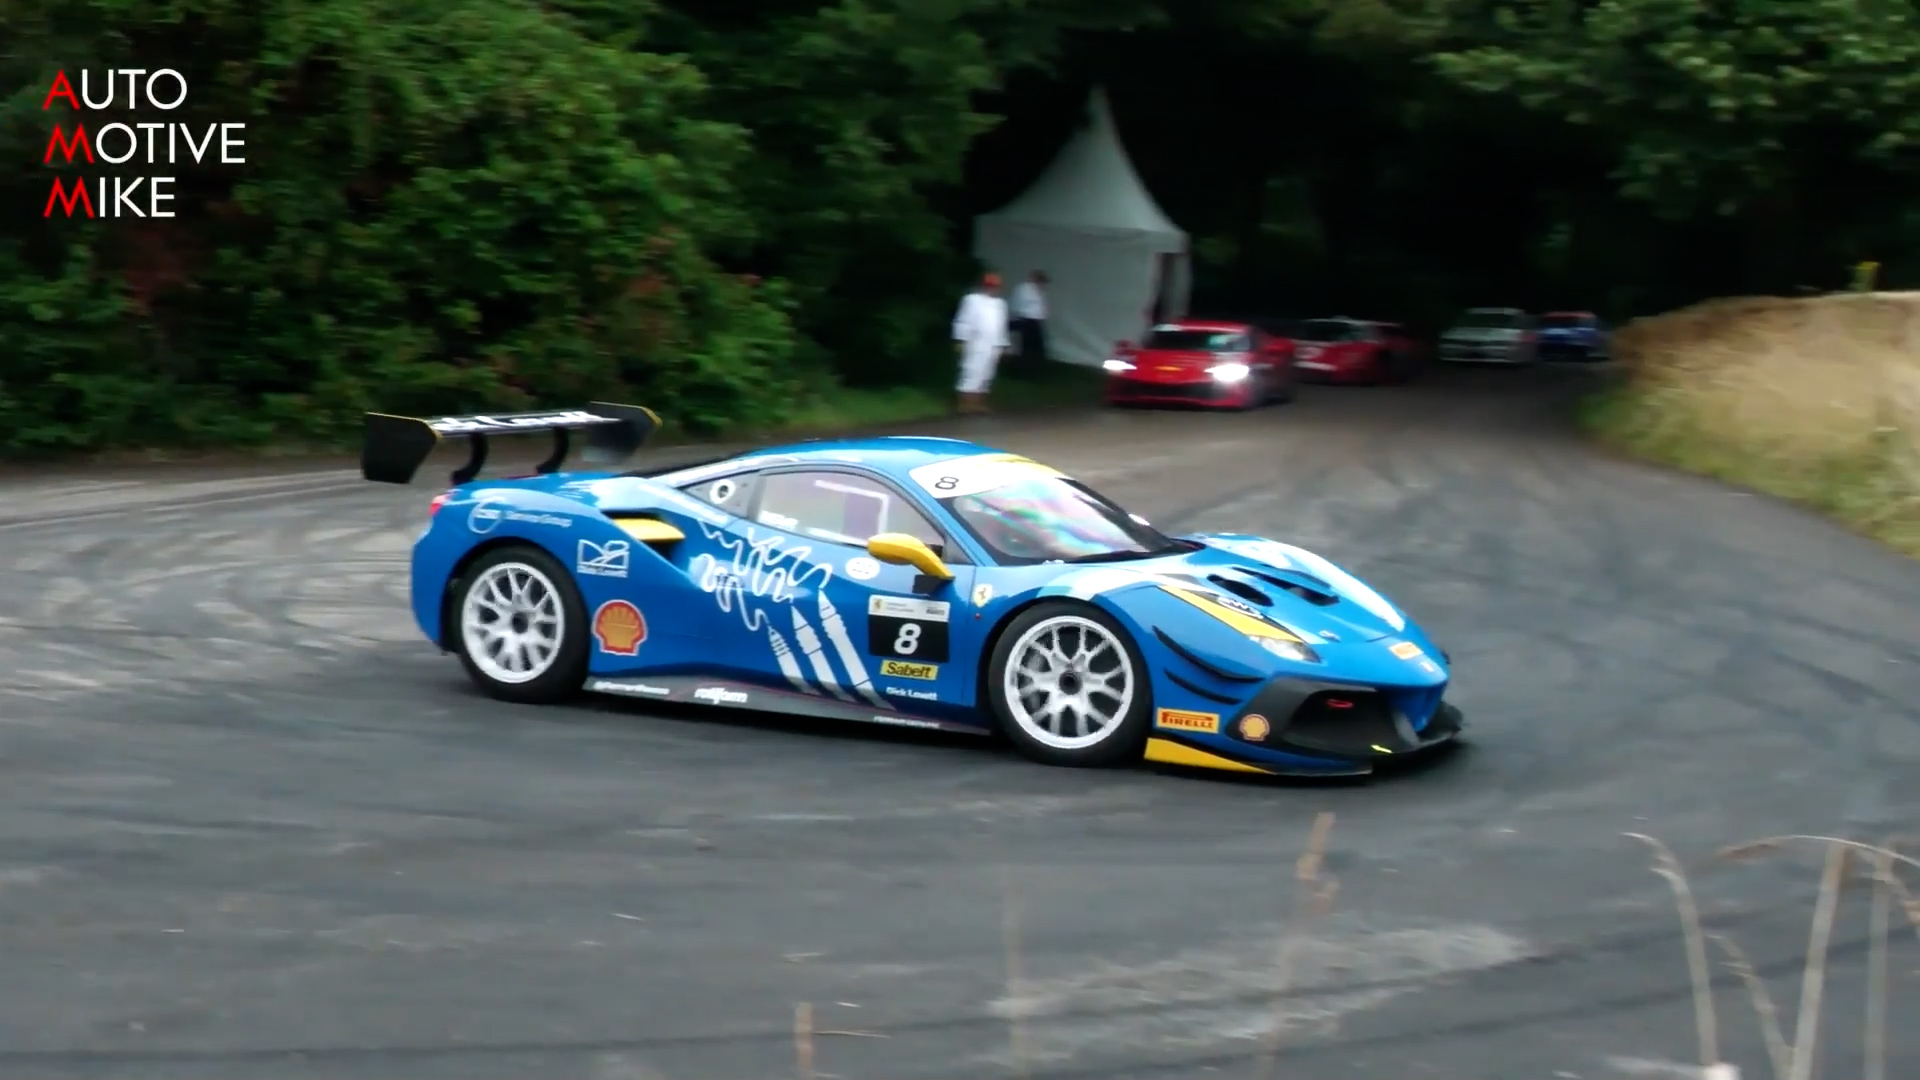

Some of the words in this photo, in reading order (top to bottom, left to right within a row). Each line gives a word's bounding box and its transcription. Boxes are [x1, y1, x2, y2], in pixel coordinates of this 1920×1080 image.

[935, 476, 960, 490] 8
[894, 623, 921, 655] 8
[1161, 710, 1214, 728] PIRELLI
